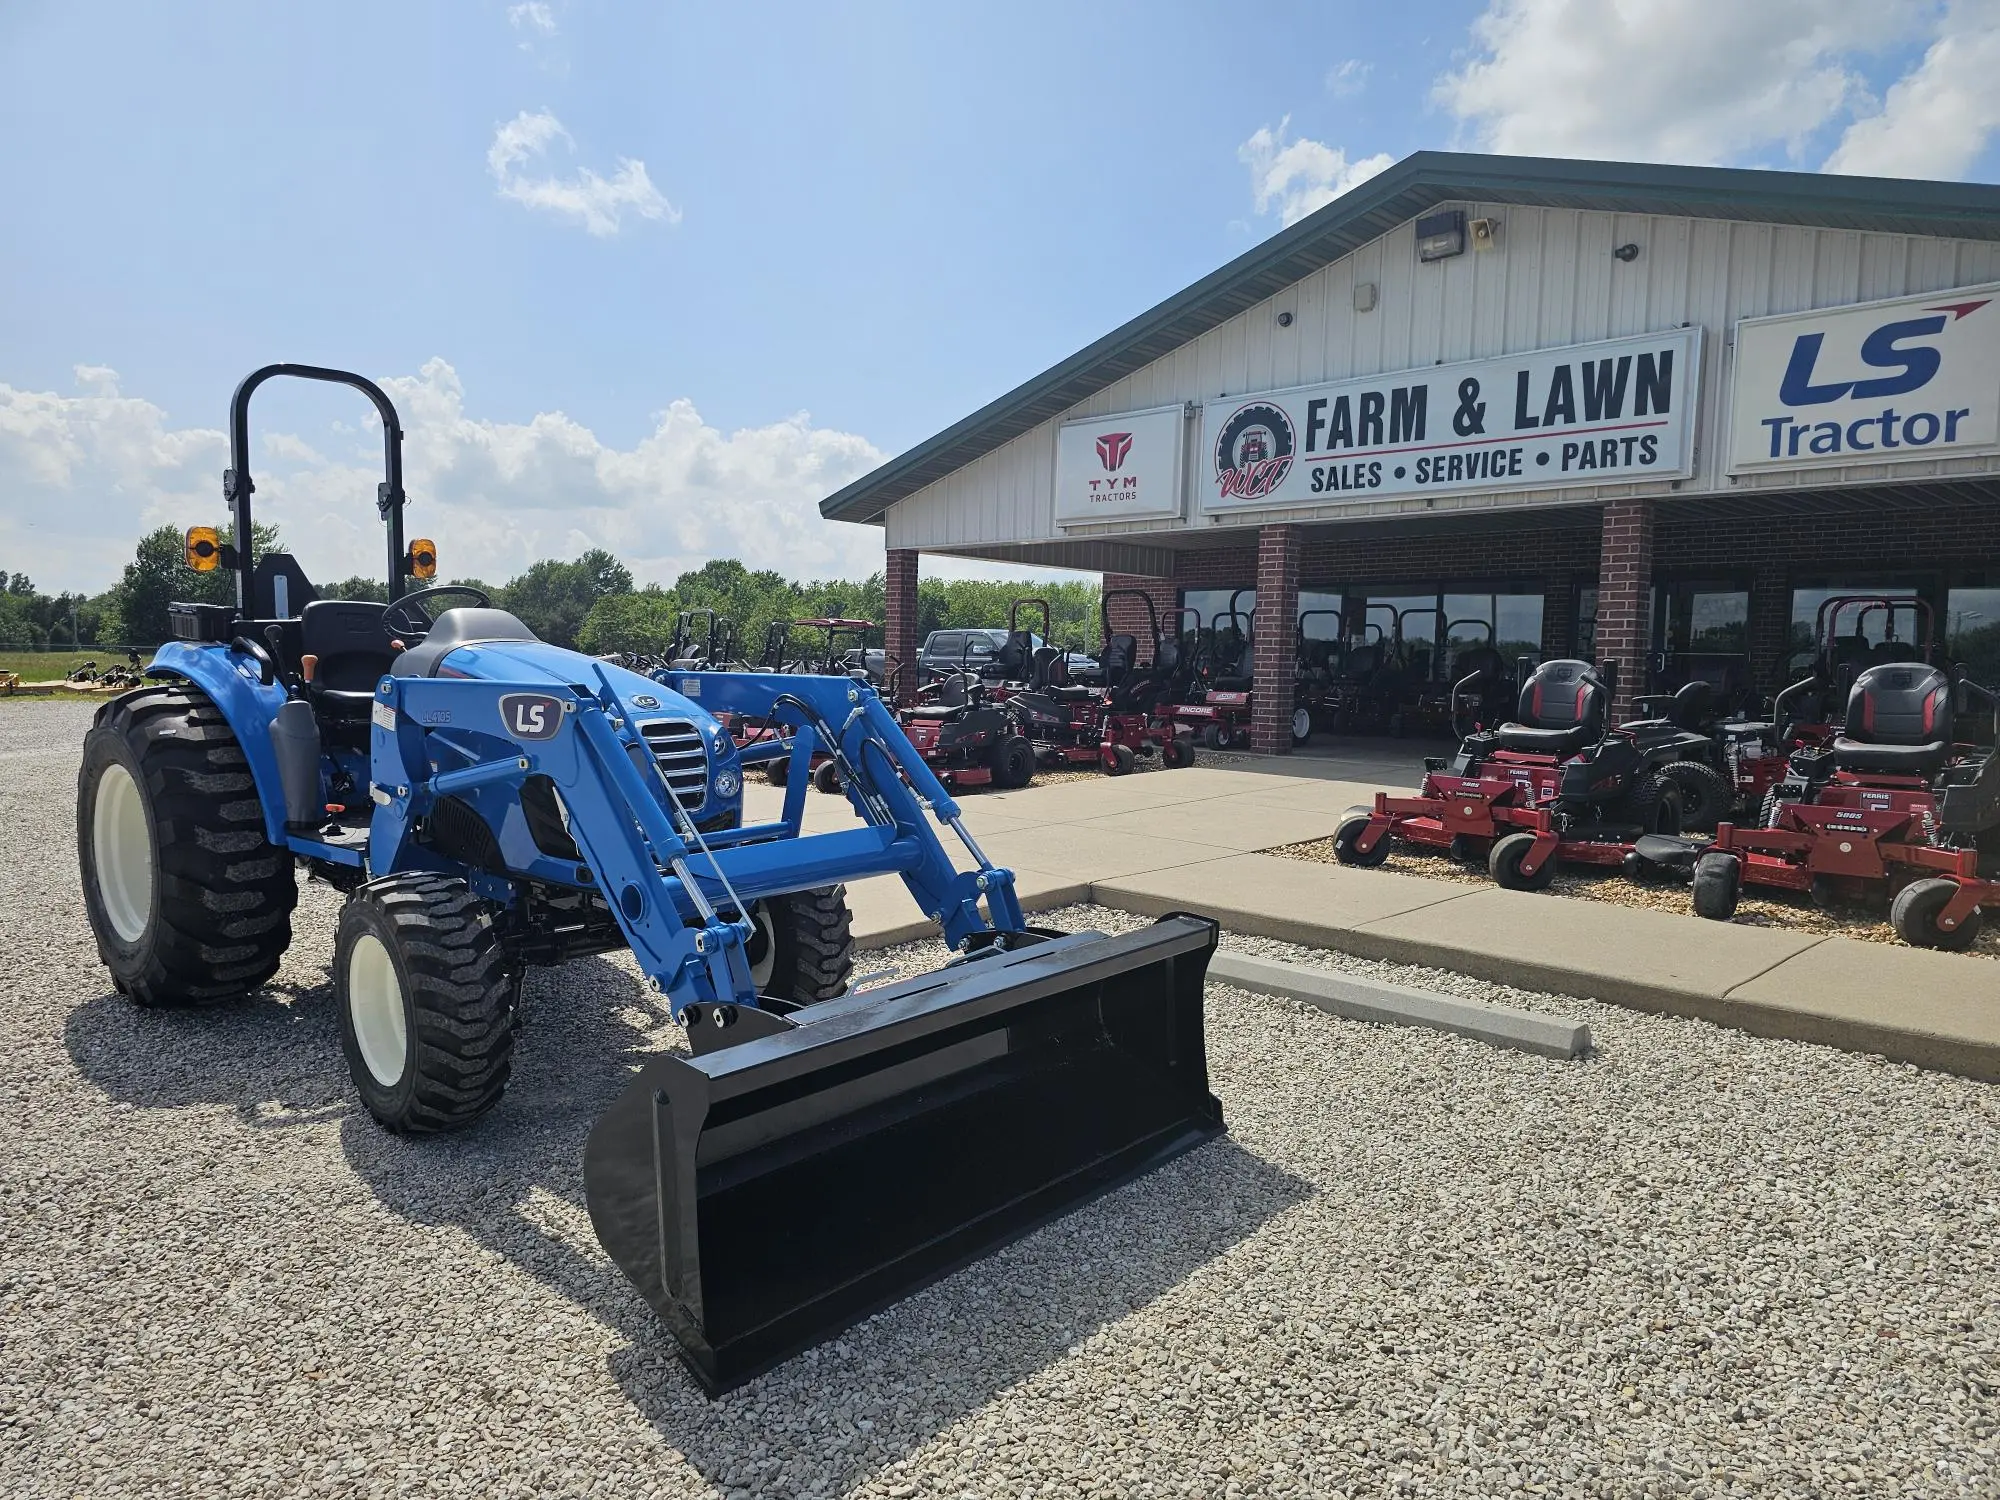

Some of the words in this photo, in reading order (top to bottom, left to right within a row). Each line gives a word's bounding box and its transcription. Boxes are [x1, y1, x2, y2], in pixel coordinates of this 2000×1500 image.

[1779, 315, 1947, 407] LS
[1305, 384, 1428, 452] FARM
[1452, 377, 1486, 438] &
[1514, 350, 1674, 430] LAWN
[1761, 408, 1970, 458] Tractor
[1215, 456, 1294, 498] WCT
[1310, 461, 1382, 493] SALES
[1415, 448, 1523, 484] SERVICE
[1561, 434, 1658, 472] PARTS
[1088, 476, 1137, 491] TYM
[1089, 491, 1137, 503] TRACTORS
[516, 704, 545, 733] LS
[1180, 706, 1213, 714] ENCORE
[1862, 792, 1890, 800] FERRIS
